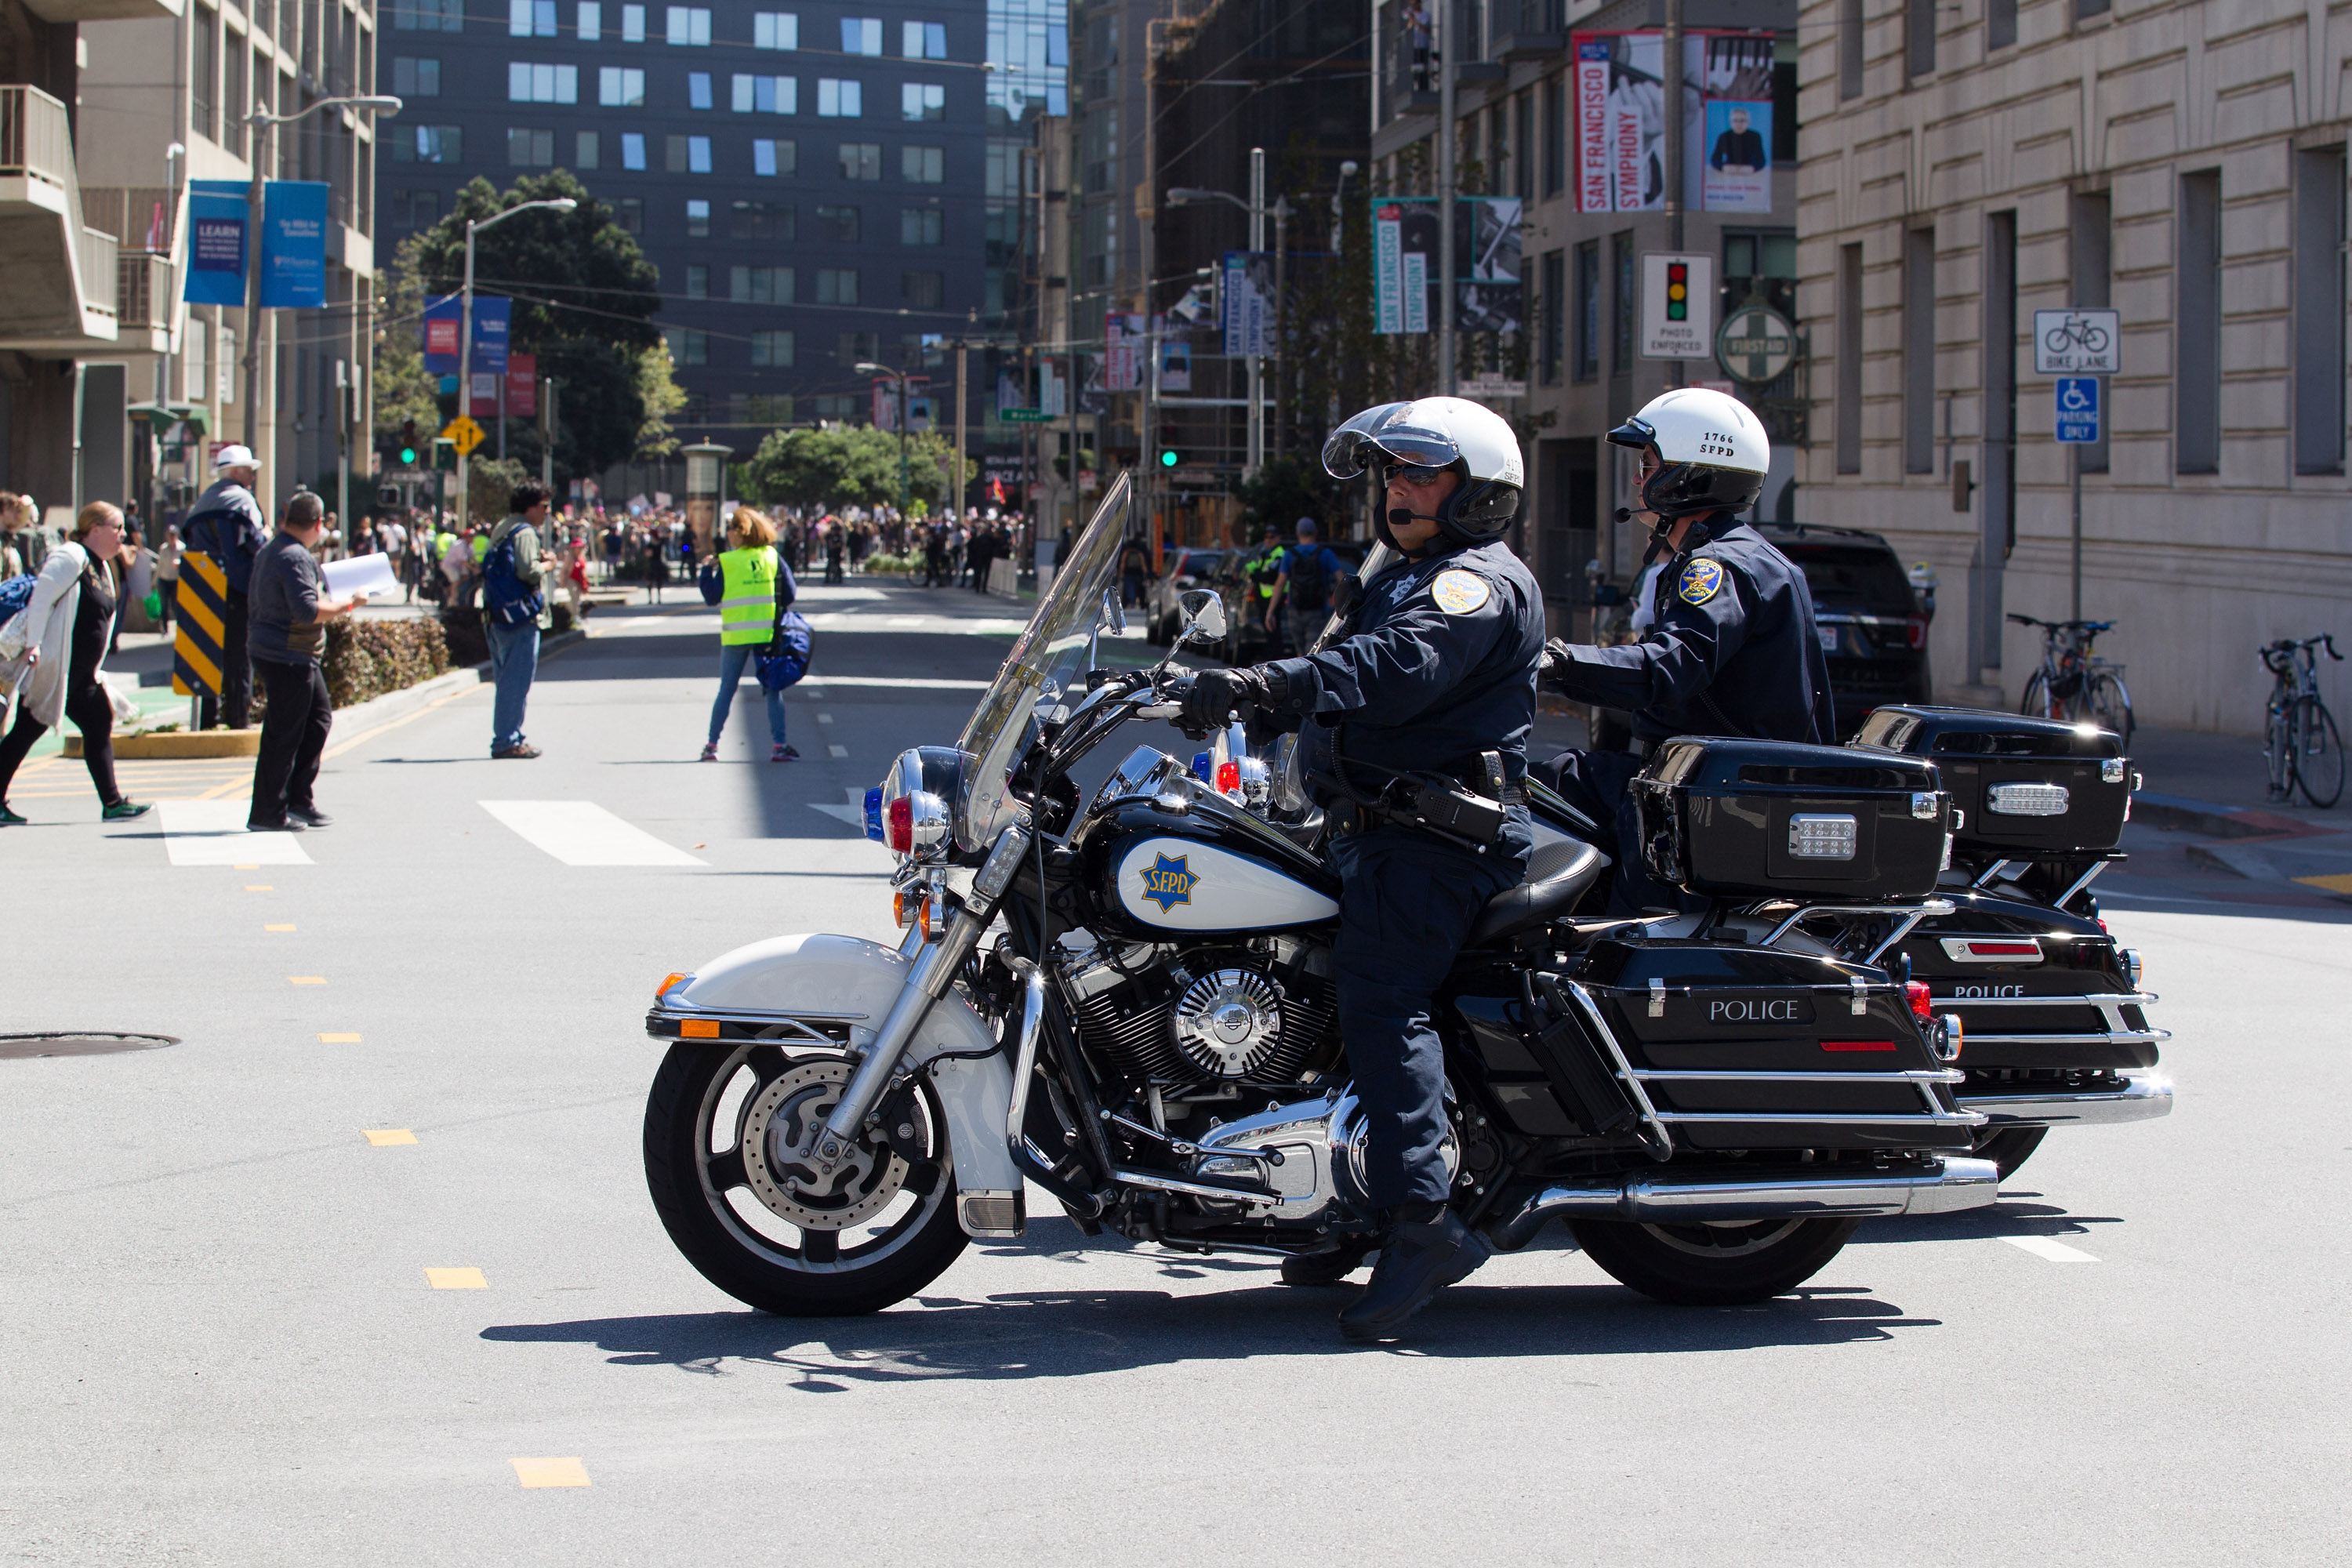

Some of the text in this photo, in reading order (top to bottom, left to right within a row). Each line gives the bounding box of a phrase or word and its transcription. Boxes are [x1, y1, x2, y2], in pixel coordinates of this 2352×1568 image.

[1584, 68, 1606, 169] FRANCISCO
[1617, 112, 1639, 209] SYMPHONY
[1587, 173, 1606, 209] SAN
[198, 225, 241, 237] LEARN
[1382, 225, 1398, 300] FRANCISCO
[1407, 257, 1424, 329] SYMPHONY
[1385, 305, 1399, 331] SAN
[1248, 297, 1261, 354] SYMPHONY
[1660, 328, 1693, 337] PHOTO
[1229, 333, 1241, 353] SAN
[1651, 341, 1702, 351] ENFORCED
[2045, 356, 2109, 368] BIKE LANE
[2056, 411, 2098, 423] PARKING
[1704, 432, 1733, 444] 1766
[2064, 426, 2089, 439] ONLY
[1700, 444, 1734, 457] SFPD
[1504, 471, 1522, 484] SFPD
[1691, 561, 1720, 572] FRANCISCO
[1149, 870, 1189, 895] S.F.P.D.
[1955, 985, 2024, 998] POLICE
[1711, 1000, 1798, 1021] POLICE
